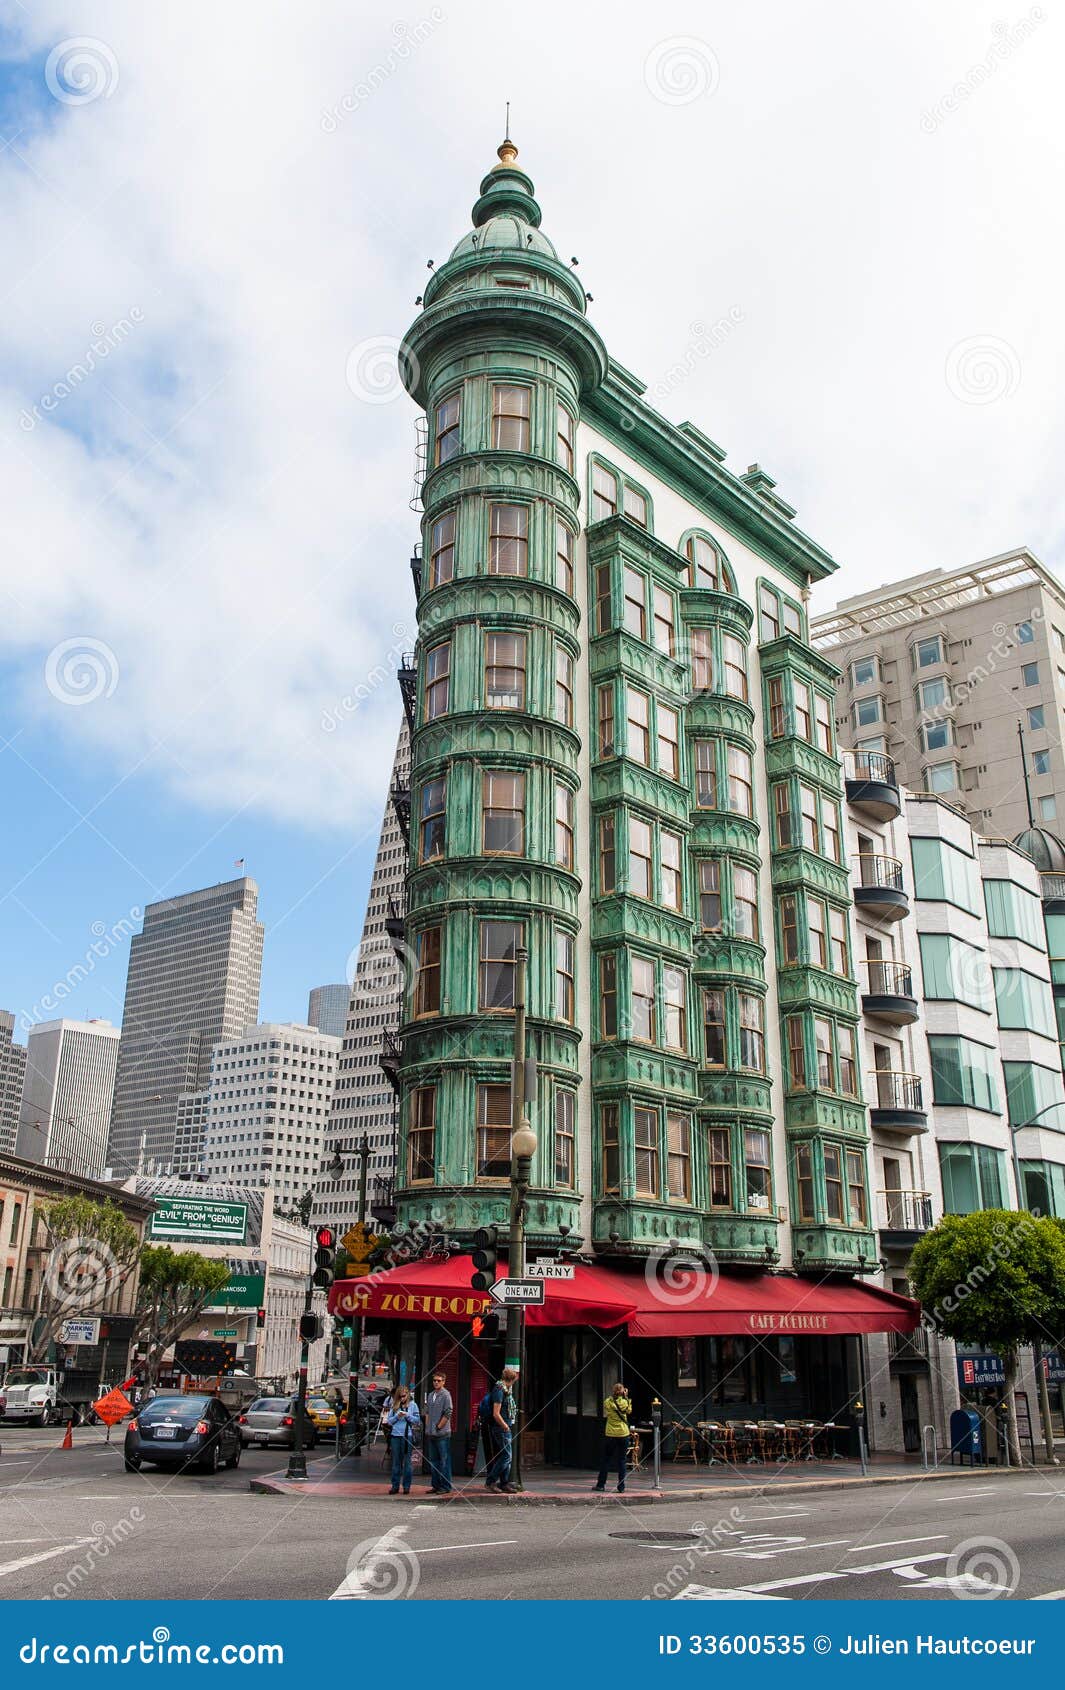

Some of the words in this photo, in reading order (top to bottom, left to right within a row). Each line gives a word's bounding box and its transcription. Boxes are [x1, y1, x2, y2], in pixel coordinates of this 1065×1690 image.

[172, 1203, 203, 1212] SEPARATING
[204, 1205, 214, 1213] THE
[182, 1212, 206, 1222] FROM
[528, 1266, 571, 1277] EARNY
[505, 1286, 520, 1296] ONE
[522, 1287, 538, 1296] WAY
